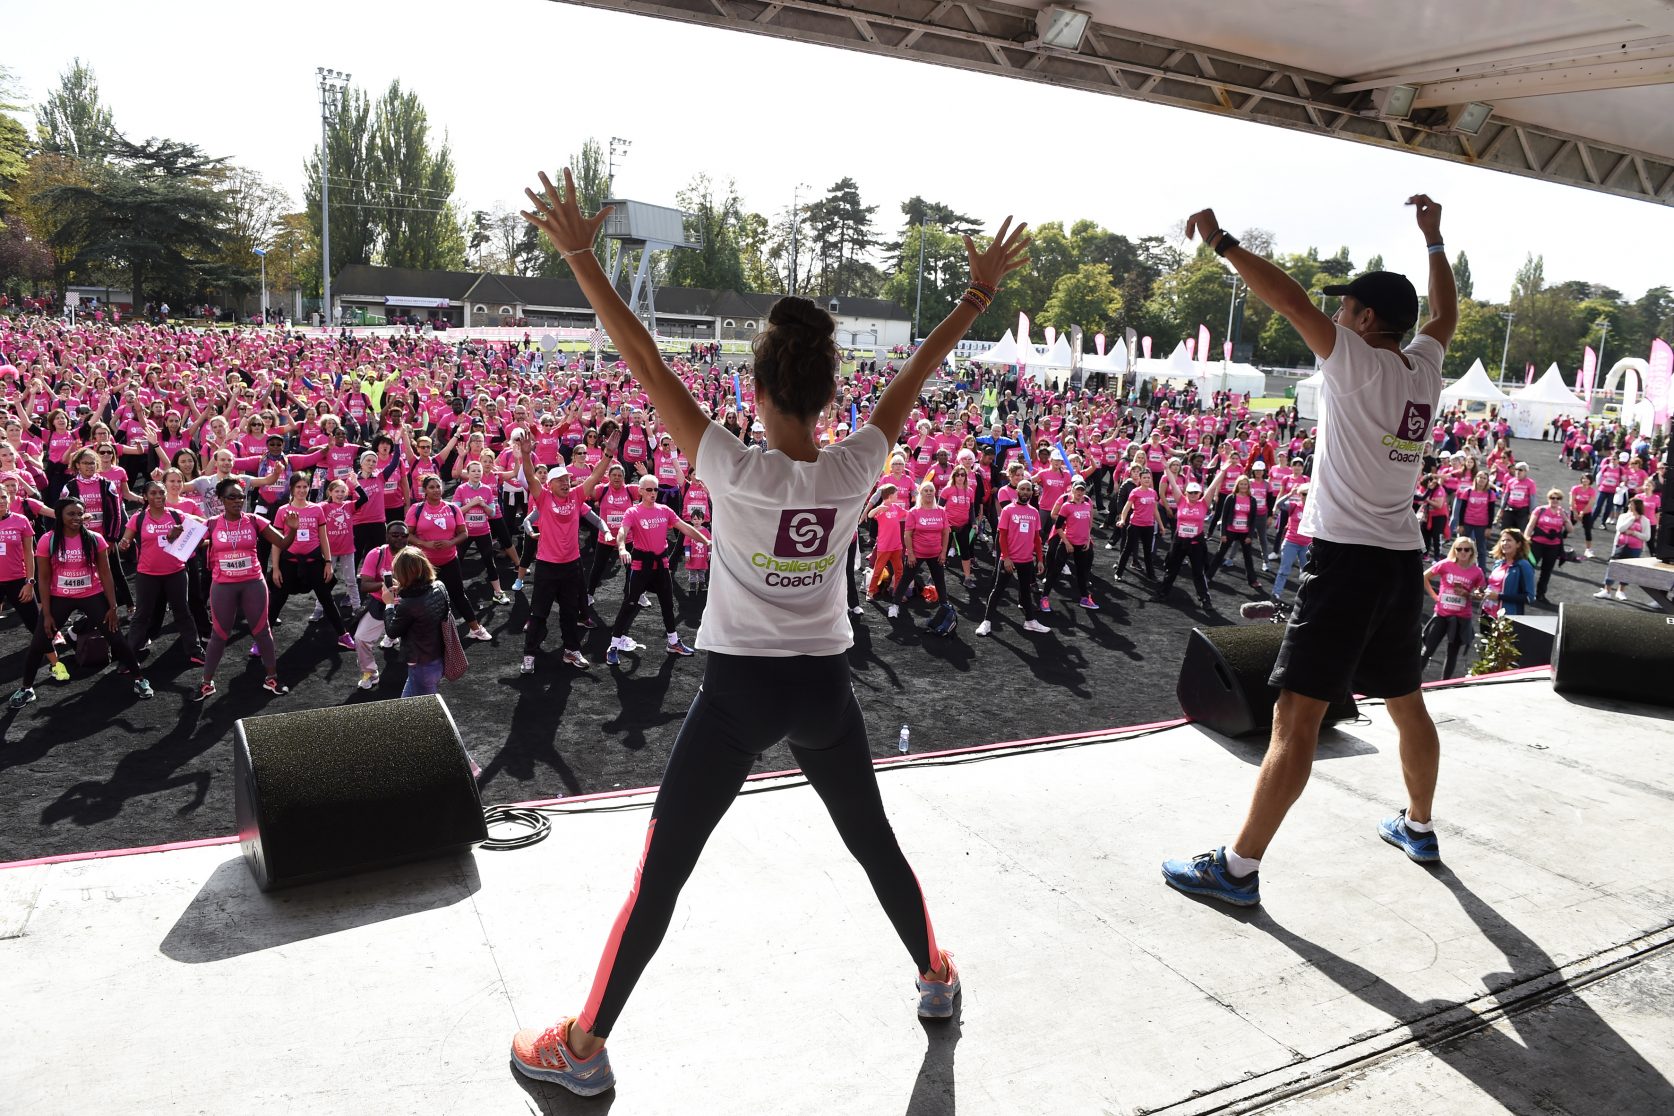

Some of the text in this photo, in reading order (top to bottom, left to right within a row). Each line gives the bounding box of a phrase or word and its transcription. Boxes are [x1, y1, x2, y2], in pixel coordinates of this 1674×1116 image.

[1389, 450, 1420, 463] Coach
[751, 552, 836, 573] Challenge
[765, 571, 823, 587] Coach
